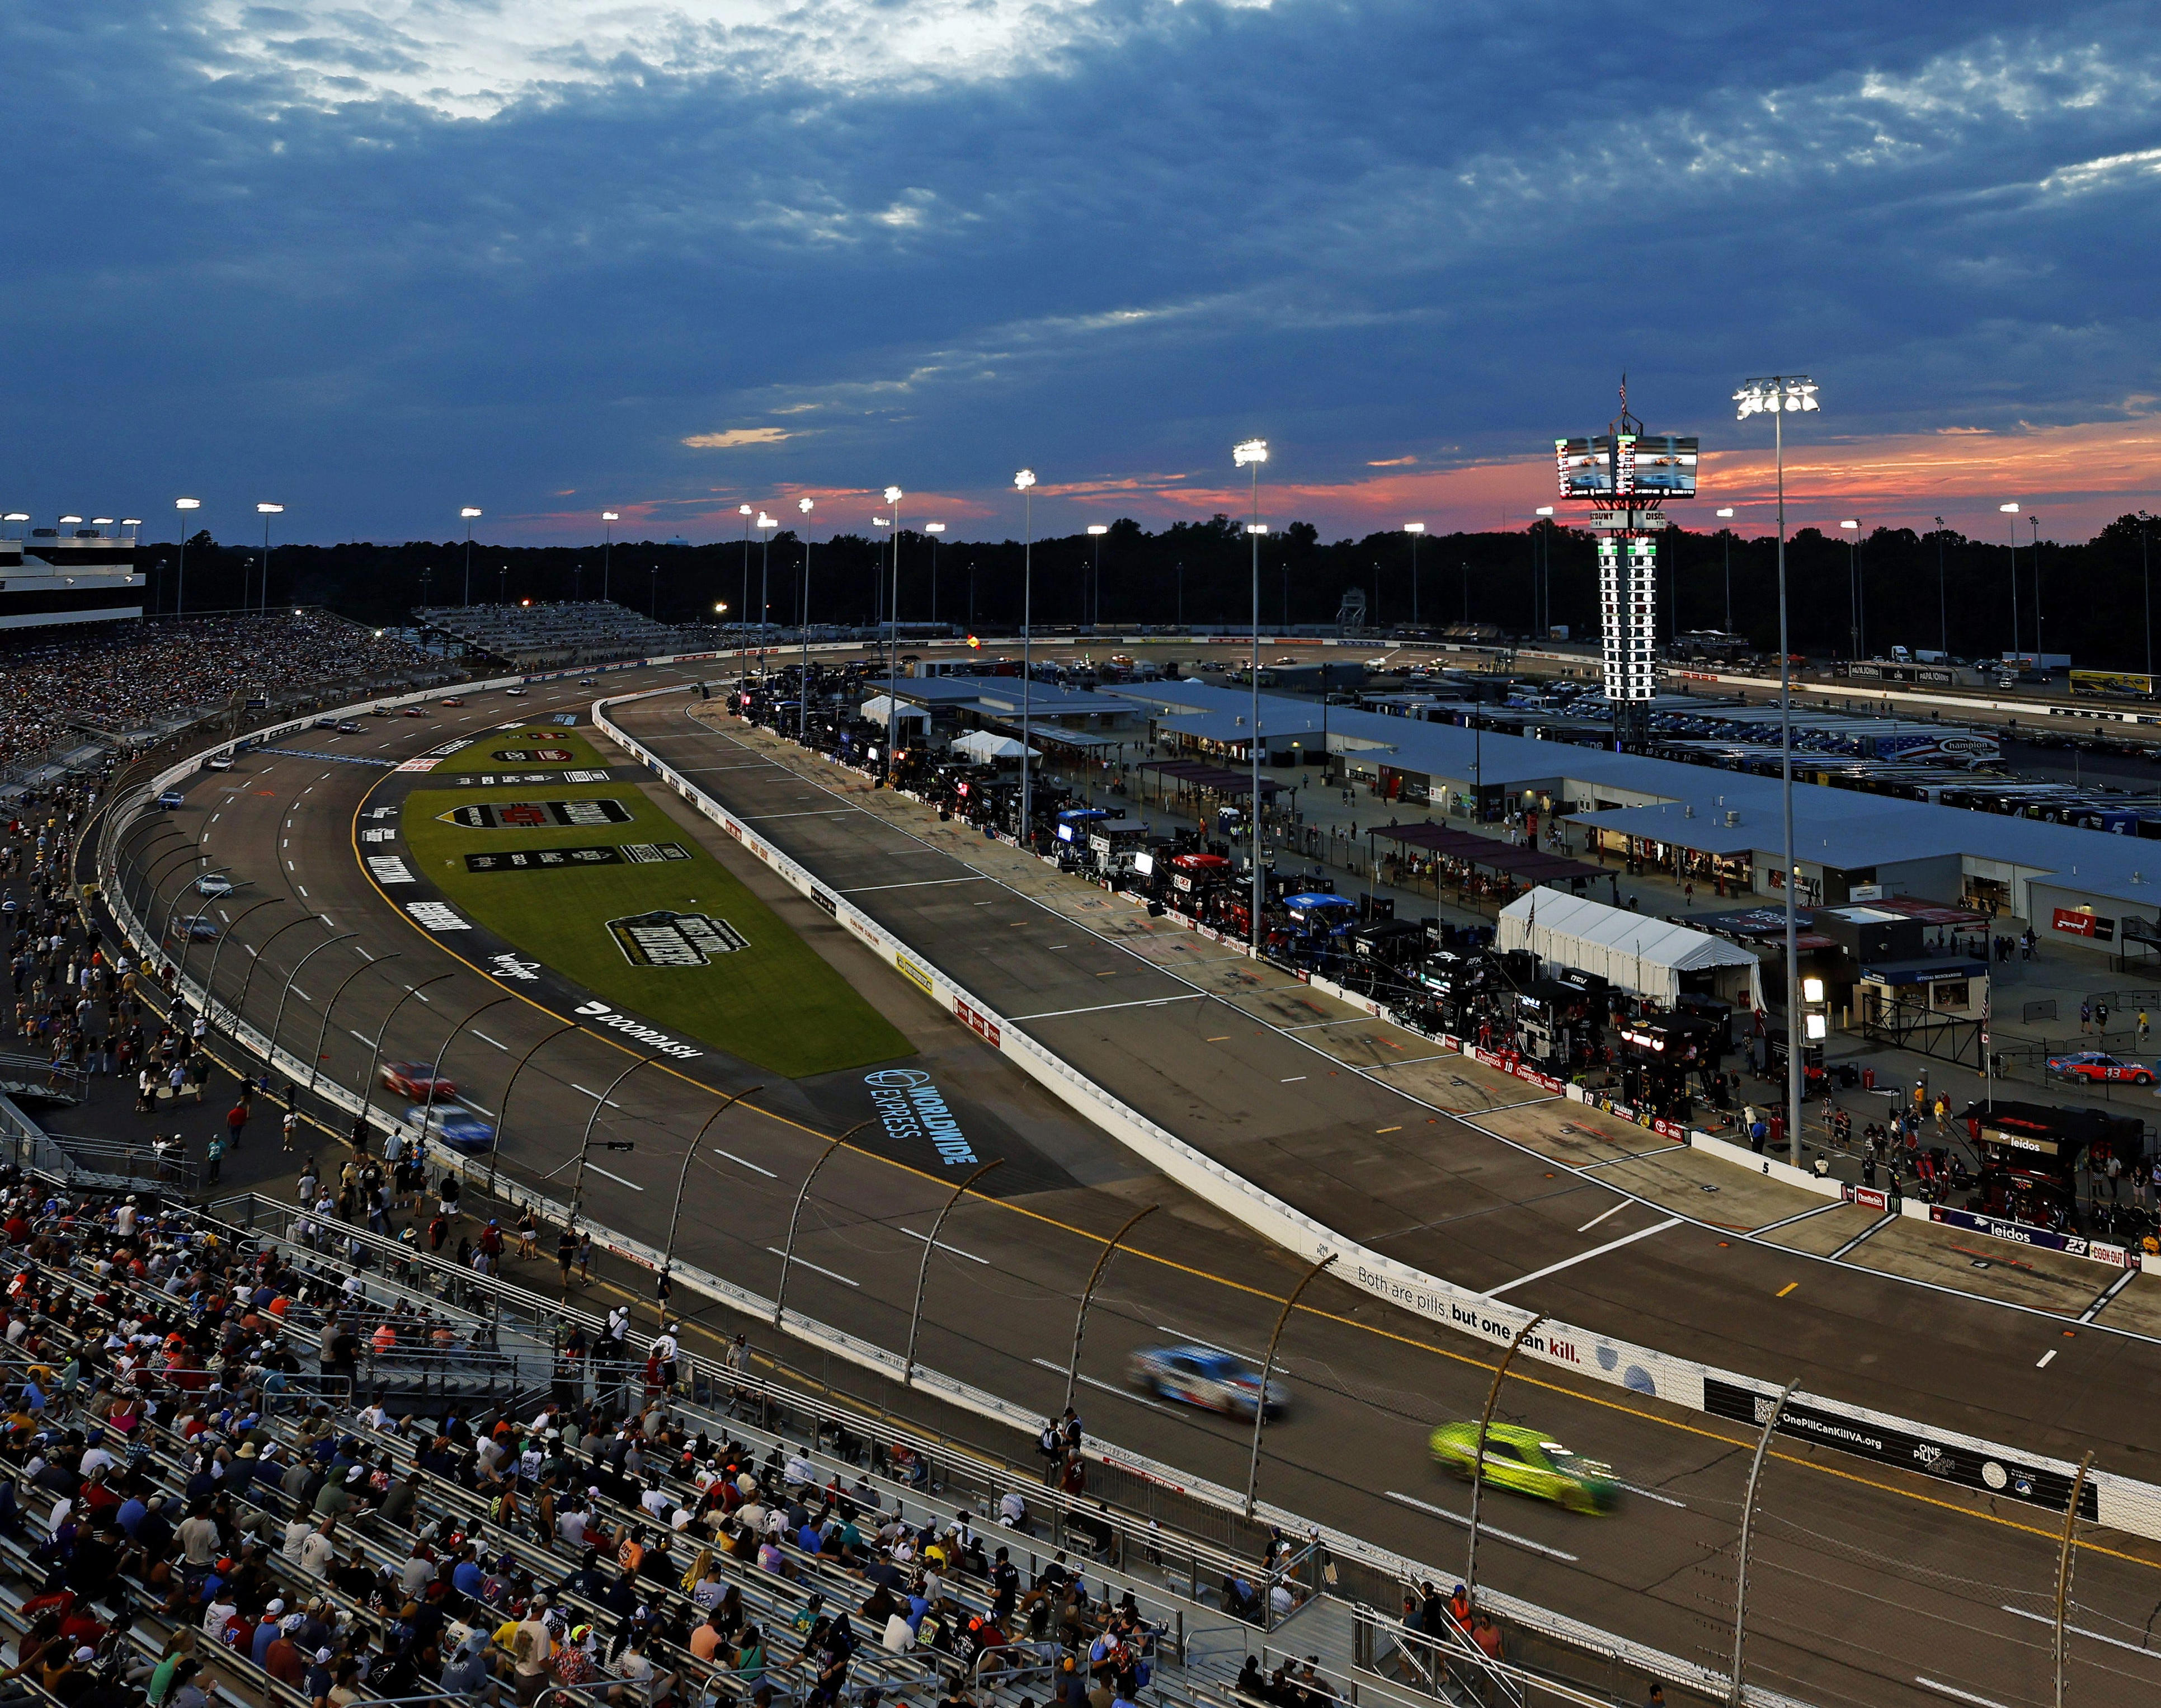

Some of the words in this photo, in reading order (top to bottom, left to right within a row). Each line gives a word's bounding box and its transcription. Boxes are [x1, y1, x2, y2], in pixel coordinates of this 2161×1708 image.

[1631, 557, 1635, 566] 1
[1630, 569, 1635, 578] 2
[1630, 581, 1636, 590] 3
[1630, 592, 1635, 602] 4
[1630, 604, 1636, 614] 5
[1630, 616, 1636, 625] 6
[1631, 627, 1635, 637] 7
[1630, 639, 1636, 650] 8
[1630, 652, 1636, 662] 9
[1628, 664, 1637, 674] 10
[1629, 677, 1637, 687] 11
[1628, 689, 1637, 698] 12
[2112, 822, 2126, 834] 5
[1339, 990, 1343, 999] 9
[595, 1014, 704, 1059] DOORDASH
[1478, 1051, 1501, 1067] Overstock
[1504, 1061, 1513, 1073] 10
[1517, 1067, 1542, 1085] Overstock
[2104, 1067, 2121, 1079] 43
[1584, 1092, 1594, 1106] 19
[870, 1089, 922, 1139] EXPRESS
[1614, 1103, 1633, 1117] TRACKER
[907, 1085, 978, 1165] WORLDWIDE
[2011, 1137, 2040, 1151] leidos
[1763, 1162, 1769, 1174] 5
[1991, 1222, 2031, 1243] leidos
[2065, 1238, 2088, 1254] 23
[2093, 1246, 2110, 1262] COOK
[2110, 1249, 2124, 1265] OUT
[6, 1279, 21, 1295] 9
[1358, 1266, 1388, 1292] Both
[1392, 1282, 1413, 1304] are
[1417, 1294, 1449, 1319] pills,
[1452, 1304, 1477, 1328] but
[1481, 1318, 1510, 1340] one
[1515, 1329, 1545, 1352] can
[1550, 1338, 1580, 1364] kill.
[1783, 1413, 1882, 1450] OnePillCanKillVA.org
[1919, 1443, 1941, 1456] ONE
[1914, 1450, 1931, 1462] PILL
[1164, 1481, 1178, 1490] FENCE
